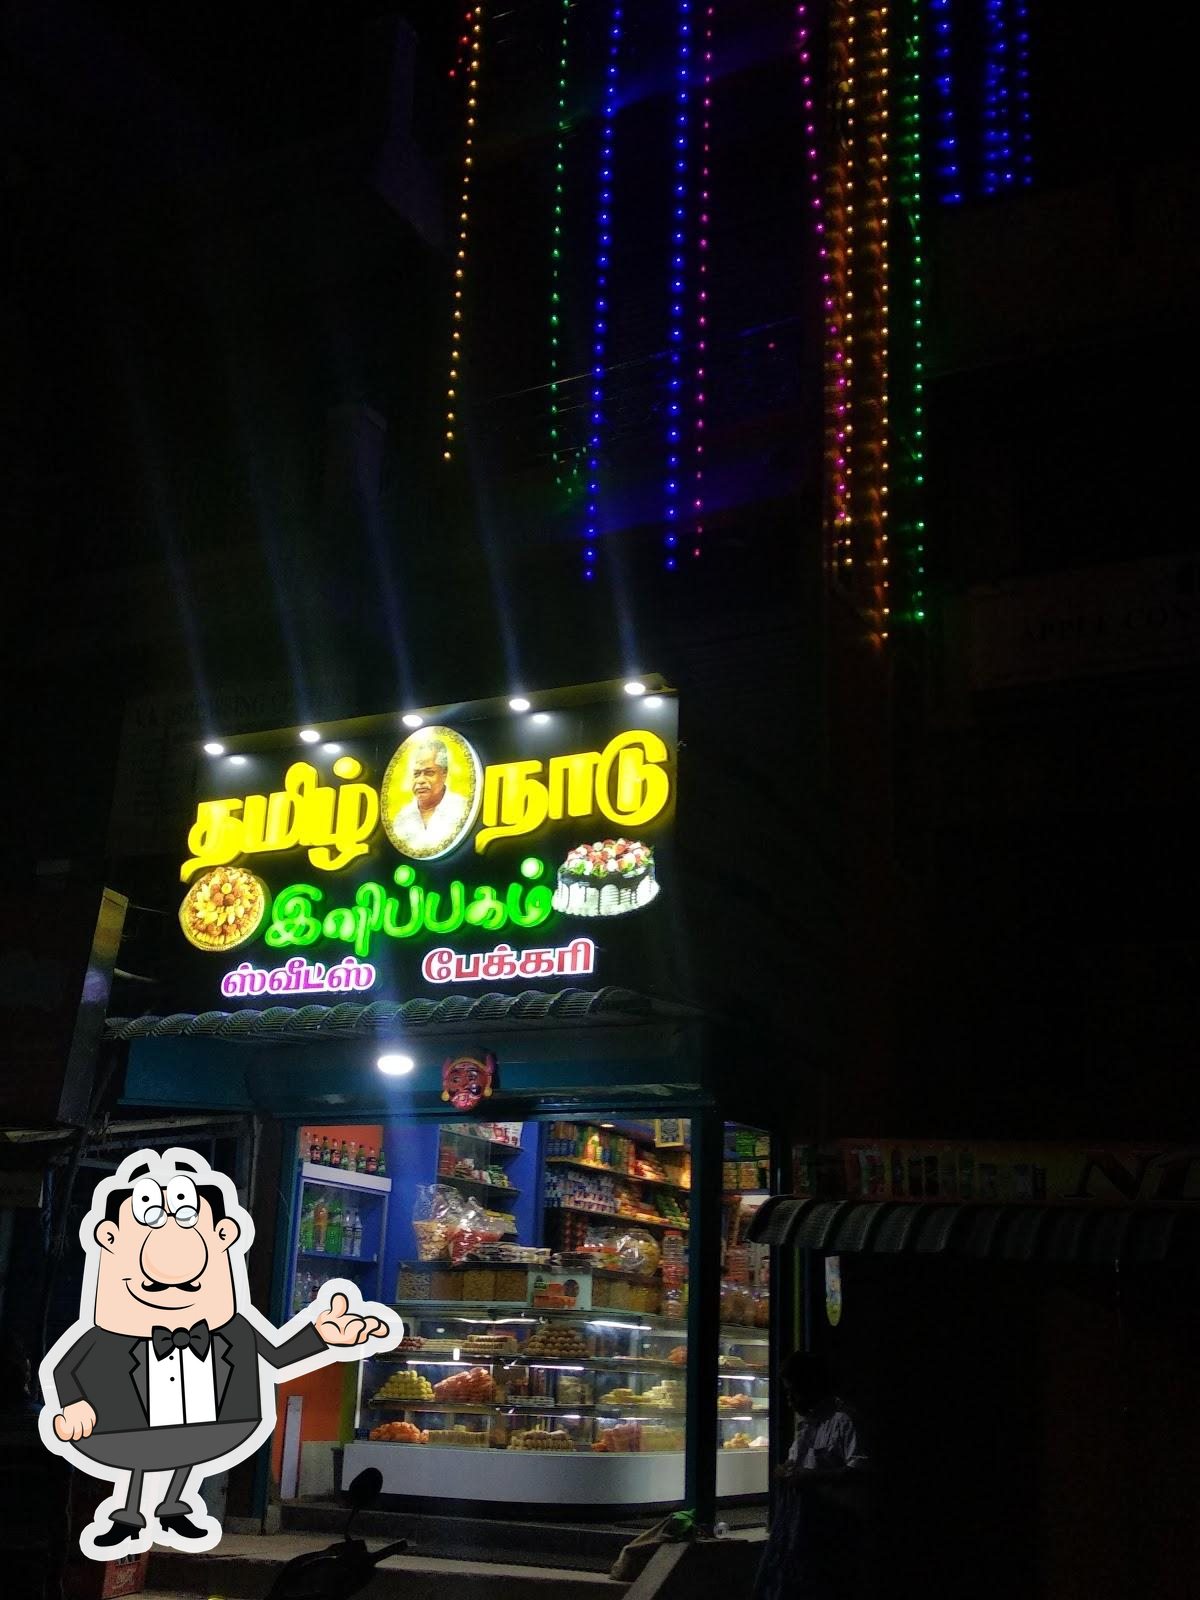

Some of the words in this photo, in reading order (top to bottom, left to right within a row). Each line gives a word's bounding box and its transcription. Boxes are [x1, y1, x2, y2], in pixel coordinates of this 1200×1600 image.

[180, 757, 379, 883] தமிழ்
[475, 730, 670, 854] நாடு
[264, 857, 553, 956] இனிப்பகம்
[220, 956, 377, 998] ஸ்வீட்ஸ்
[422, 938, 595, 984] பேக்கரி
